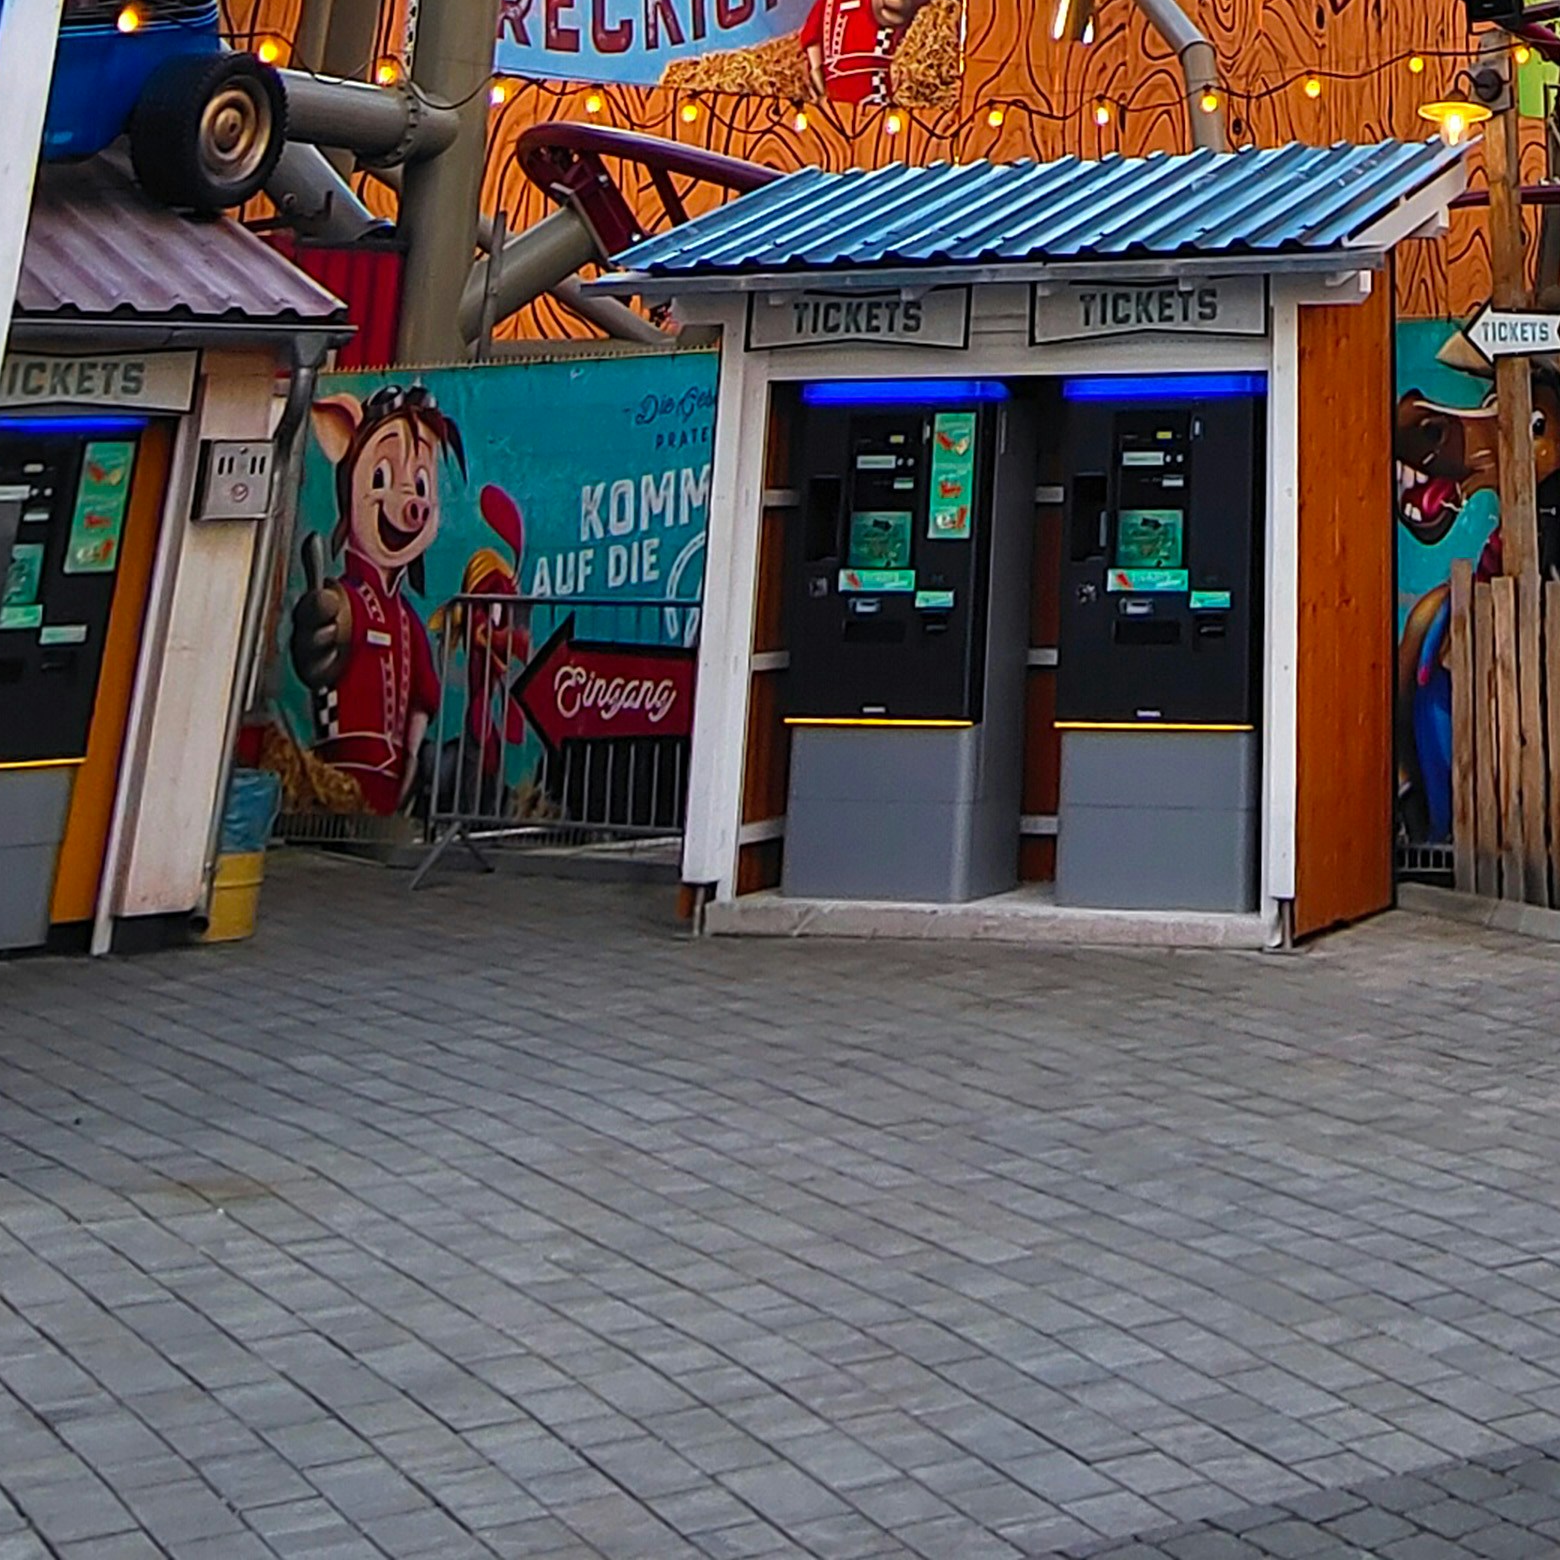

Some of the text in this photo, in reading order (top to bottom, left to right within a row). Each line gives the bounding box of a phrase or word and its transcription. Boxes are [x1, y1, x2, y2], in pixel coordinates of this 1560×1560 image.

[793, 300, 922, 335] TICKETS
[1078, 289, 1219, 327] TICKETS
[1482, 321, 1550, 342] TICKETS
[5, 361, 145, 396] ICKETS
[531, 539, 660, 597] AUF DIE
[554, 665, 677, 723] Eingang
